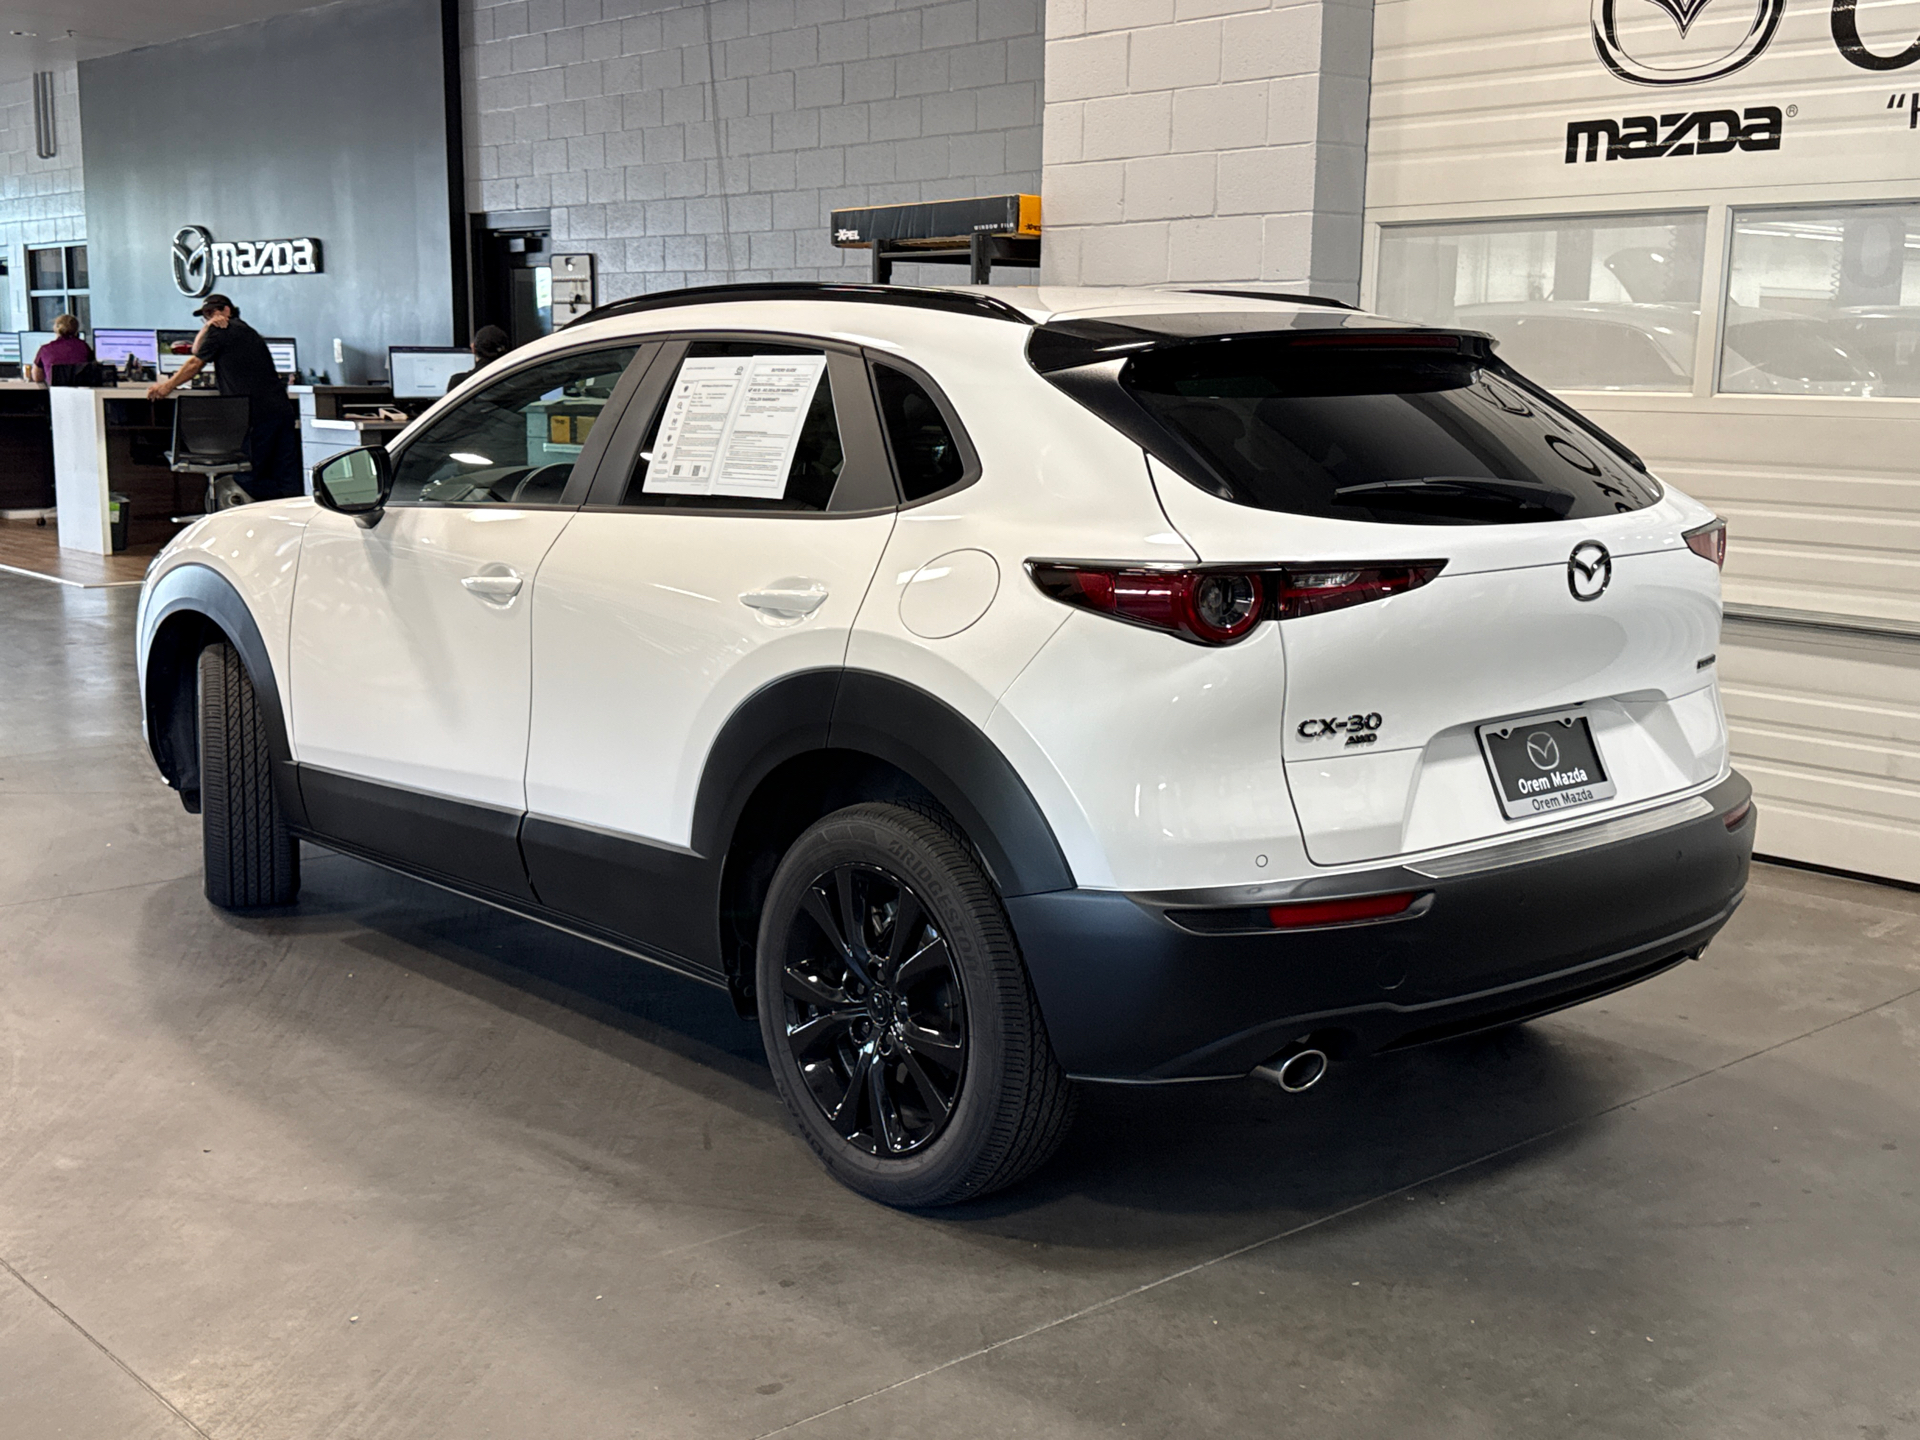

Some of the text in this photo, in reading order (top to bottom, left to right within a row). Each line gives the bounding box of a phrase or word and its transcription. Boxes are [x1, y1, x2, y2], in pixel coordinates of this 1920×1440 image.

[1564, 105, 1783, 164] mazda
[834, 228, 860, 241] XPEL
[973, 223, 999, 231] WINDOW
[210, 237, 318, 276] mazda
[1297, 711, 1383, 738] CX-30
[1344, 733, 1378, 746] AWD
[1518, 767, 1589, 795] Orem Mazda
[1531, 788, 1594, 811] Orem Mazda
[888, 839, 985, 988] BRIDGESTONE
